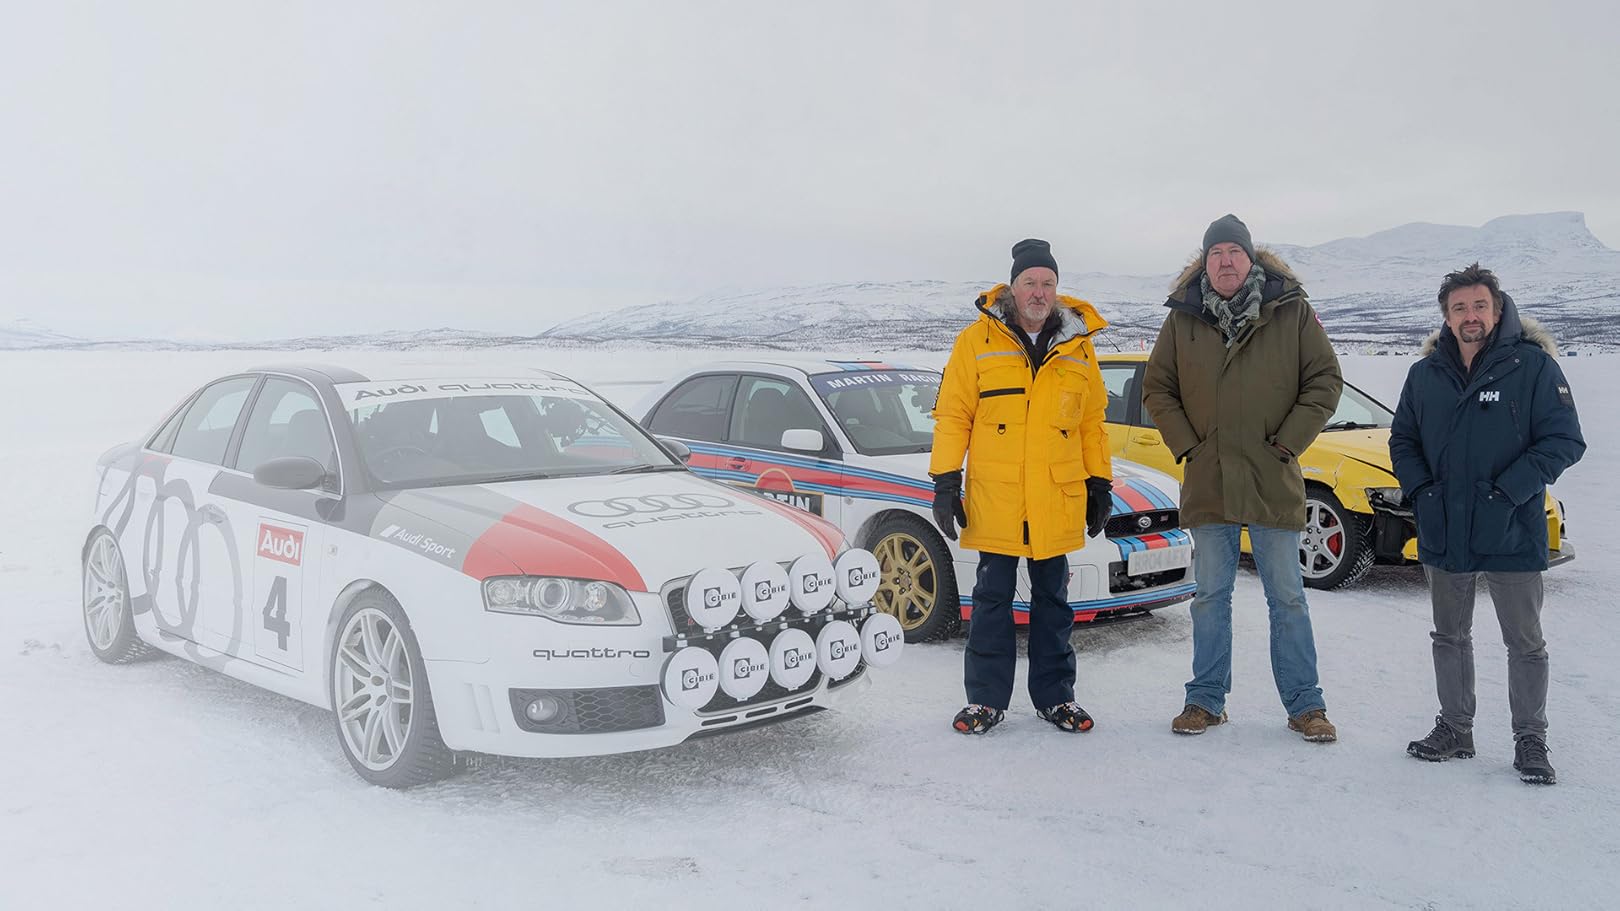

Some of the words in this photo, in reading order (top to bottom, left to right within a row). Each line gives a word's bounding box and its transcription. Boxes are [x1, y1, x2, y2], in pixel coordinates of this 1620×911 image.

[826, 374, 893, 389] MARTIN
[898, 374, 940, 384] RACIN
[355, 384, 428, 401] Audi
[438, 382, 590, 396] quattro
[1479, 391, 1500, 402] HH
[602, 510, 763, 529] quattro
[260, 530, 300, 561] Audi
[393, 528, 424, 546] Audi
[422, 537, 457, 559] Sport
[711, 592, 737, 602] CIBIE
[761, 584, 786, 595] CIBIE
[263, 576, 290, 651] 4
[533, 647, 650, 660] quattro
